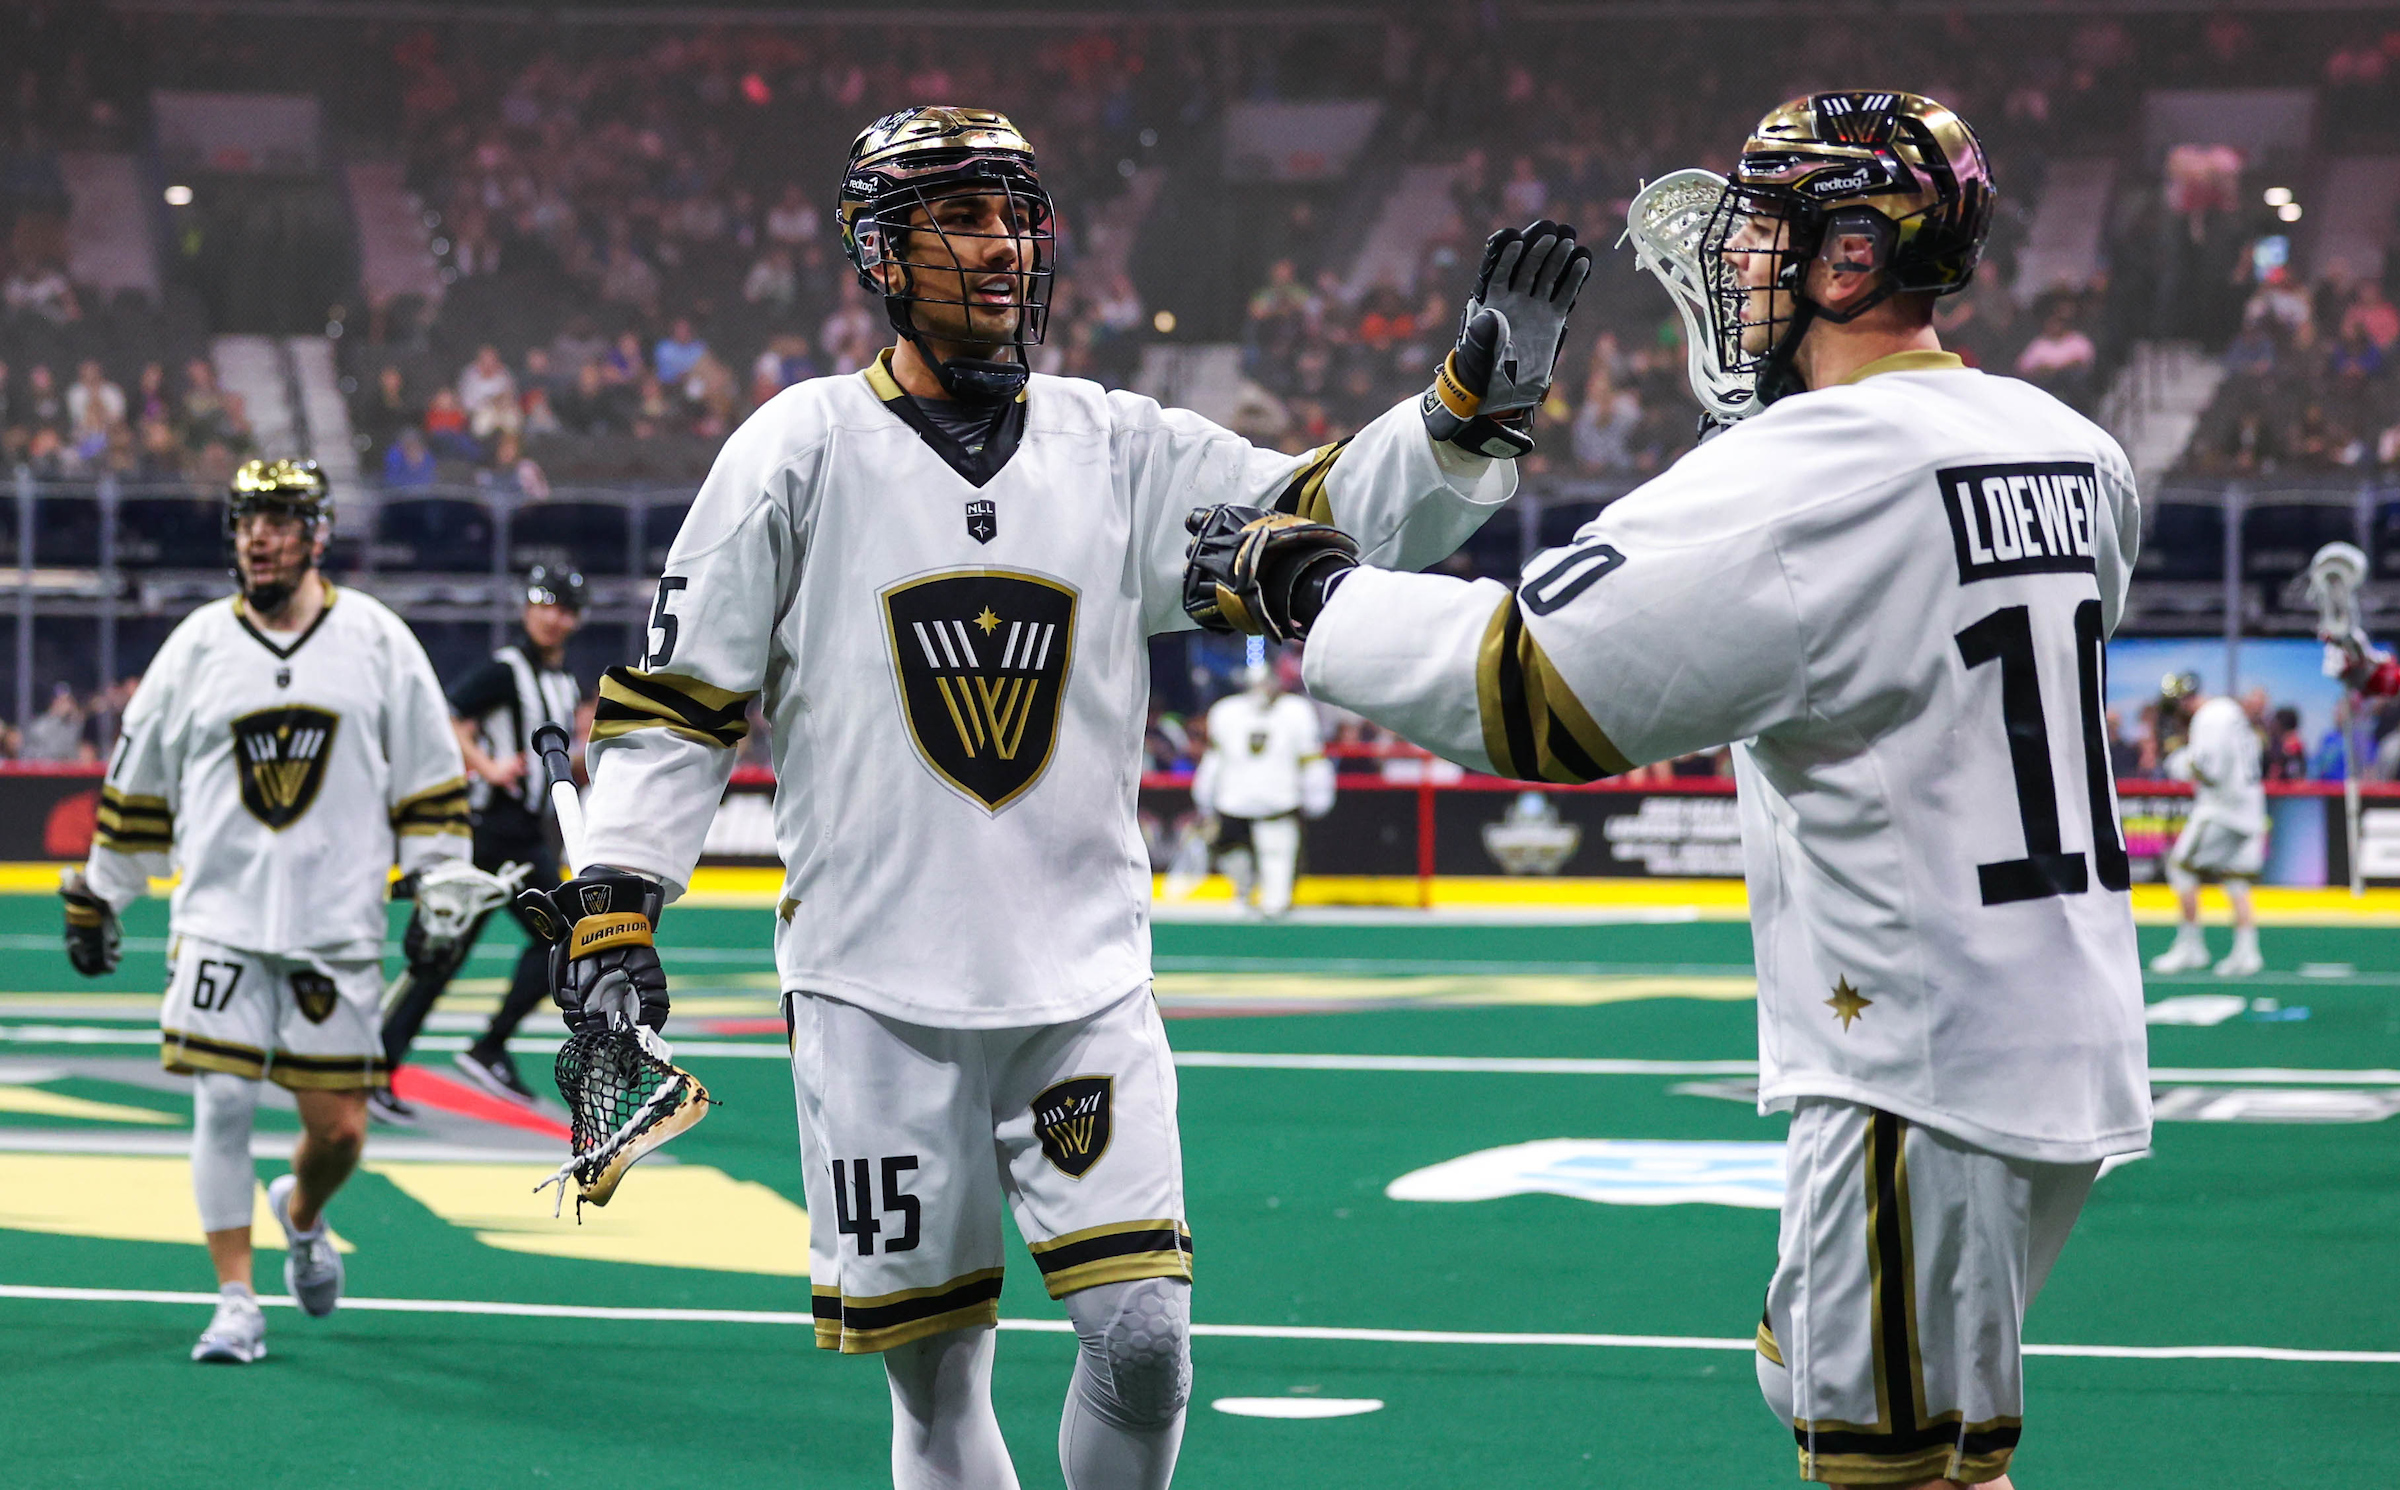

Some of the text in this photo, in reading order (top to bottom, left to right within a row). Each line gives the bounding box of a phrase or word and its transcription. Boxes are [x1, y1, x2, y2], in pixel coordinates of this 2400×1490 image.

[967, 503, 993, 515] NLL
[1520, 535, 1627, 616] 0
[645, 577, 688, 673] 5
[1954, 598, 2131, 907] 10
[581, 922, 647, 946] WARRIOR
[193, 959, 244, 1013] 67
[832, 1155, 921, 1256] 45
